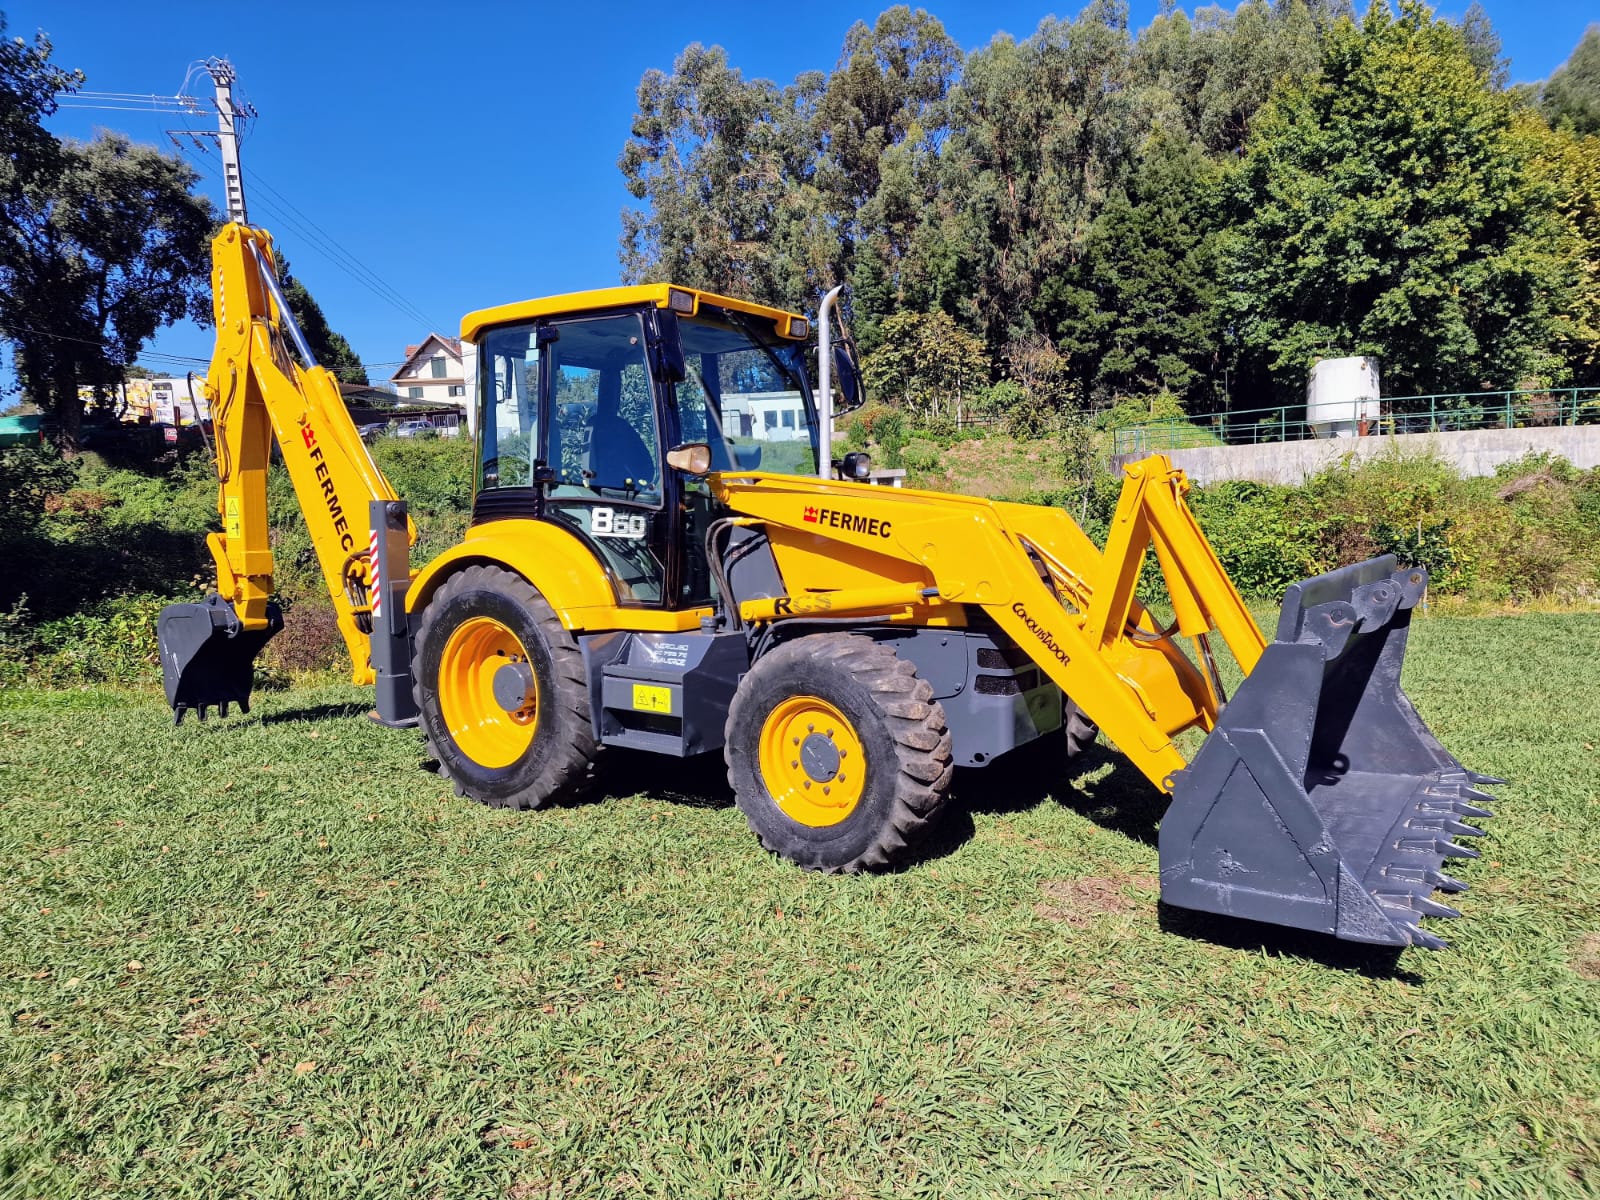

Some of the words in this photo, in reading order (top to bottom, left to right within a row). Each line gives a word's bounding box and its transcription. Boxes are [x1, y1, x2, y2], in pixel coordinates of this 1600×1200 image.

[310, 446, 354, 552] FERMEC
[819, 508, 892, 538] FERMEC
[1012, 602, 1071, 667] CONQUISTADOR
